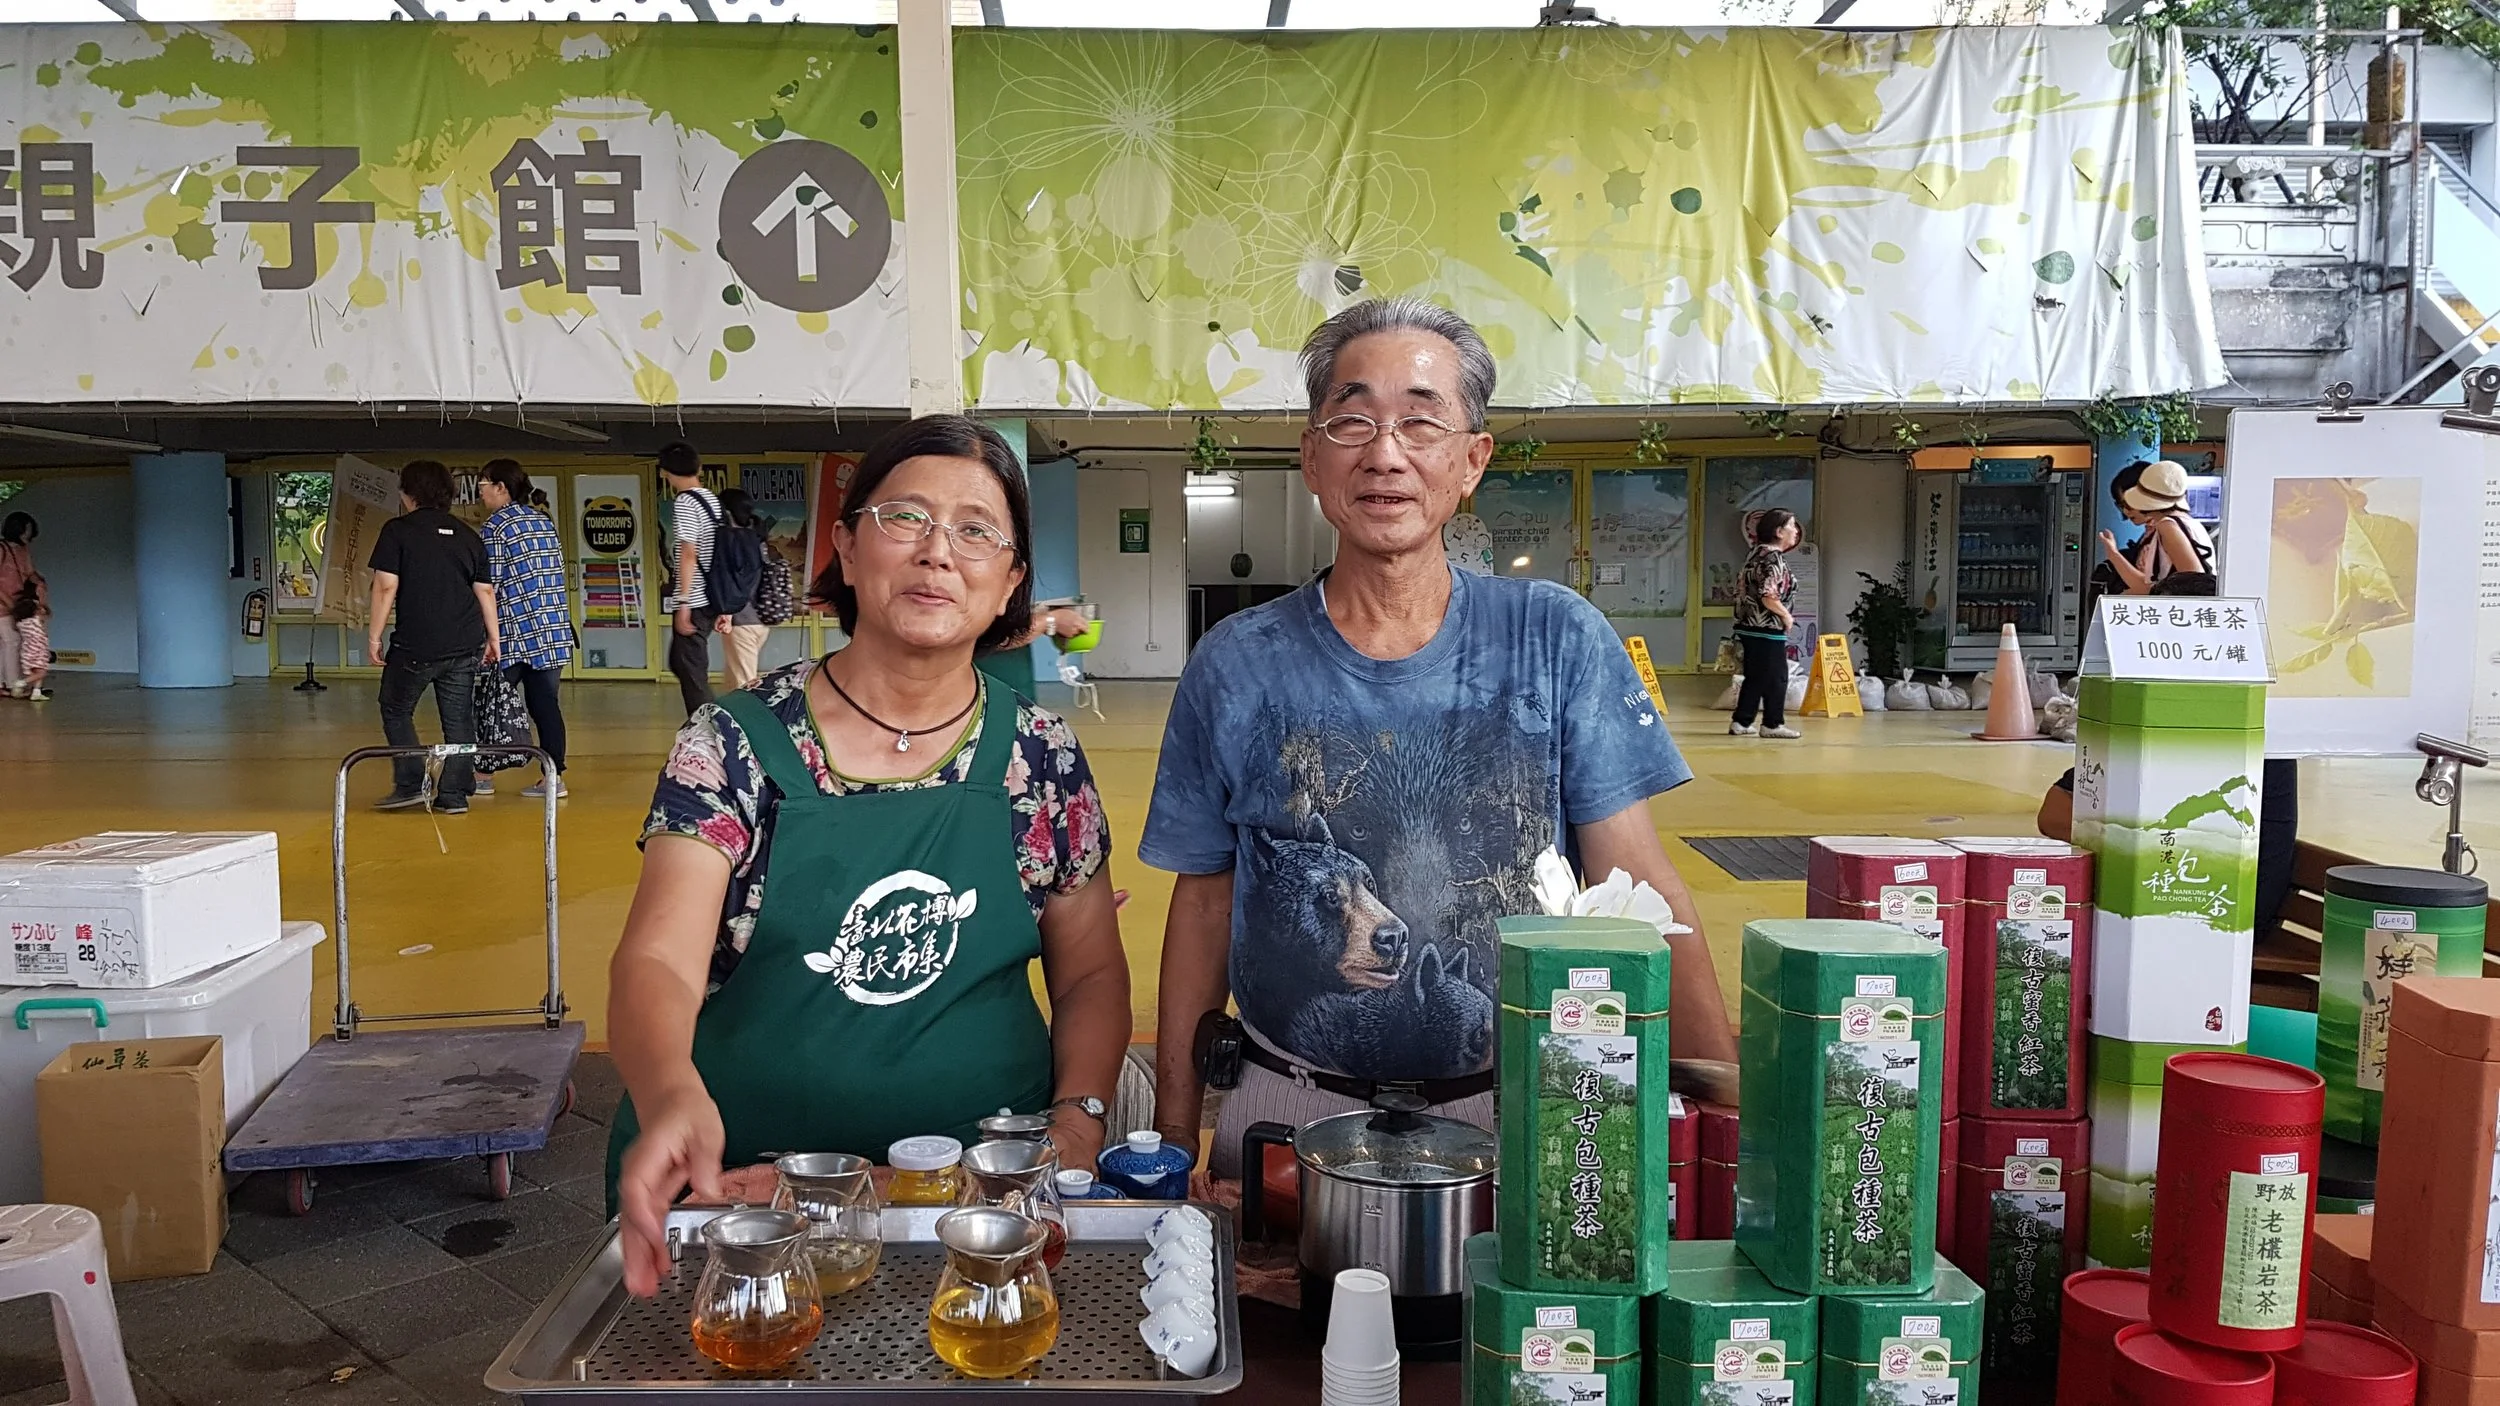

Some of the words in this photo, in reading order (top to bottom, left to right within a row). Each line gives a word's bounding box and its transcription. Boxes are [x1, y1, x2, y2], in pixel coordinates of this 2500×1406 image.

[764, 467, 805, 501] LEARN
[585, 516, 632, 529] TOMORROW'S
[593, 533, 626, 545] LEADER
[2109, 603, 2248, 630] 炭焙包種茶
[2137, 641, 2183, 660] 1000
[2193, 644, 2248, 664] 元/罐
[2160, 831, 2176, 864] 南港
[2169, 895, 2193, 903] CHONG
[2173, 888, 2207, 896] NANKUNG
[11, 923, 57, 941] サンふじ
[75, 924, 93, 941] 峰
[78, 944, 96, 962] 28
[834, 929, 944, 987] 農民市集
[2018, 946, 2046, 1077] 復古蜜香紅茶
[1570, 1069, 1604, 1239] 復古包種茶
[1852, 1076, 1887, 1243] 復古包種茶
[2255, 1183, 2297, 1202] 野放
[2011, 1217, 2039, 1345] 復古蜜香紅茶
[1542, 1310, 1574, 1327] 700元
